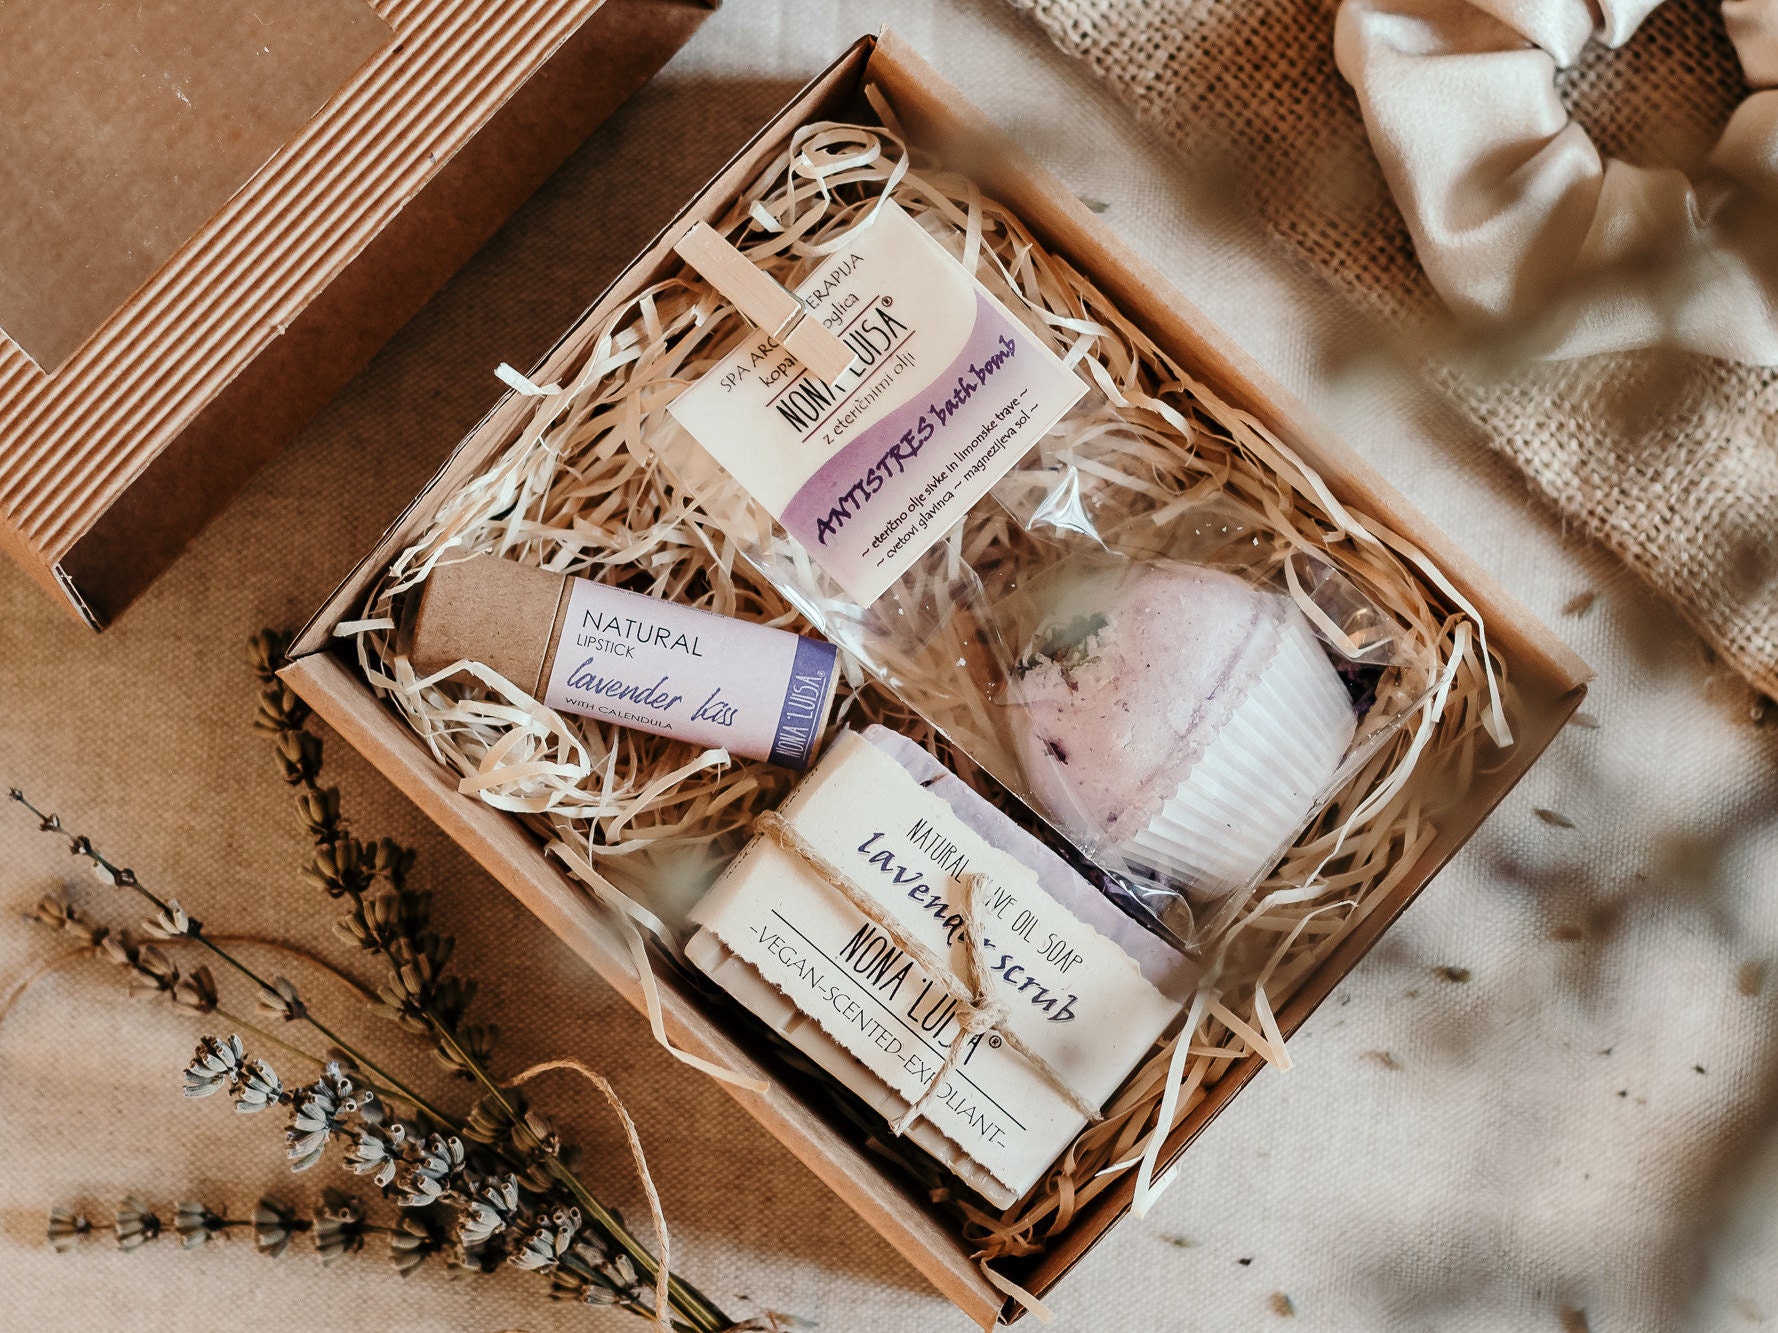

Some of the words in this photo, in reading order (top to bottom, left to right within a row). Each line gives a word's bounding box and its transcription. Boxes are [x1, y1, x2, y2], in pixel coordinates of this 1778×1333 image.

[720, 365, 751, 393] SPA
[750, 253, 865, 368] AROERAPIJA
[758, 349, 798, 388] kopal
[822, 292, 860, 330] oglica
[822, 434, 835, 445] z
[832, 371, 895, 436] eteričnimi
[893, 351, 917, 375] olji
[994, 397, 1021, 422] trave
[816, 416, 936, 546] ANTISTRES
[928, 377, 979, 427] bath
[968, 334, 1017, 386] bomb
[953, 418, 998, 463] limonske
[886, 524, 919, 560] cvetovi
[917, 490, 955, 530] glavinca
[963, 427, 1018, 483] magnezijeva
[1014, 411, 1032, 431] sol
[924, 469, 949, 497] sivke
[948, 458, 959, 474] in
[907, 492, 927, 515] olje
[871, 511, 908, 550] eterično
[576, 633, 636, 659] LIPSTICK
[582, 609, 704, 658] NATURAL
[565, 696, 595, 712] WITH
[597, 705, 674, 731] CALENDULA
[566, 656, 683, 712] lavender
[690, 686, 739, 728] kiss
[775, 725, 809, 758] NONA
[906, 817, 970, 885] NATURAL
[984, 886, 1019, 920] IVE
[1011, 909, 1039, 943] OIL
[1036, 933, 1084, 974] SOAP
[839, 922, 915, 1001] NONA
[990, 954, 1080, 1022] scrub
